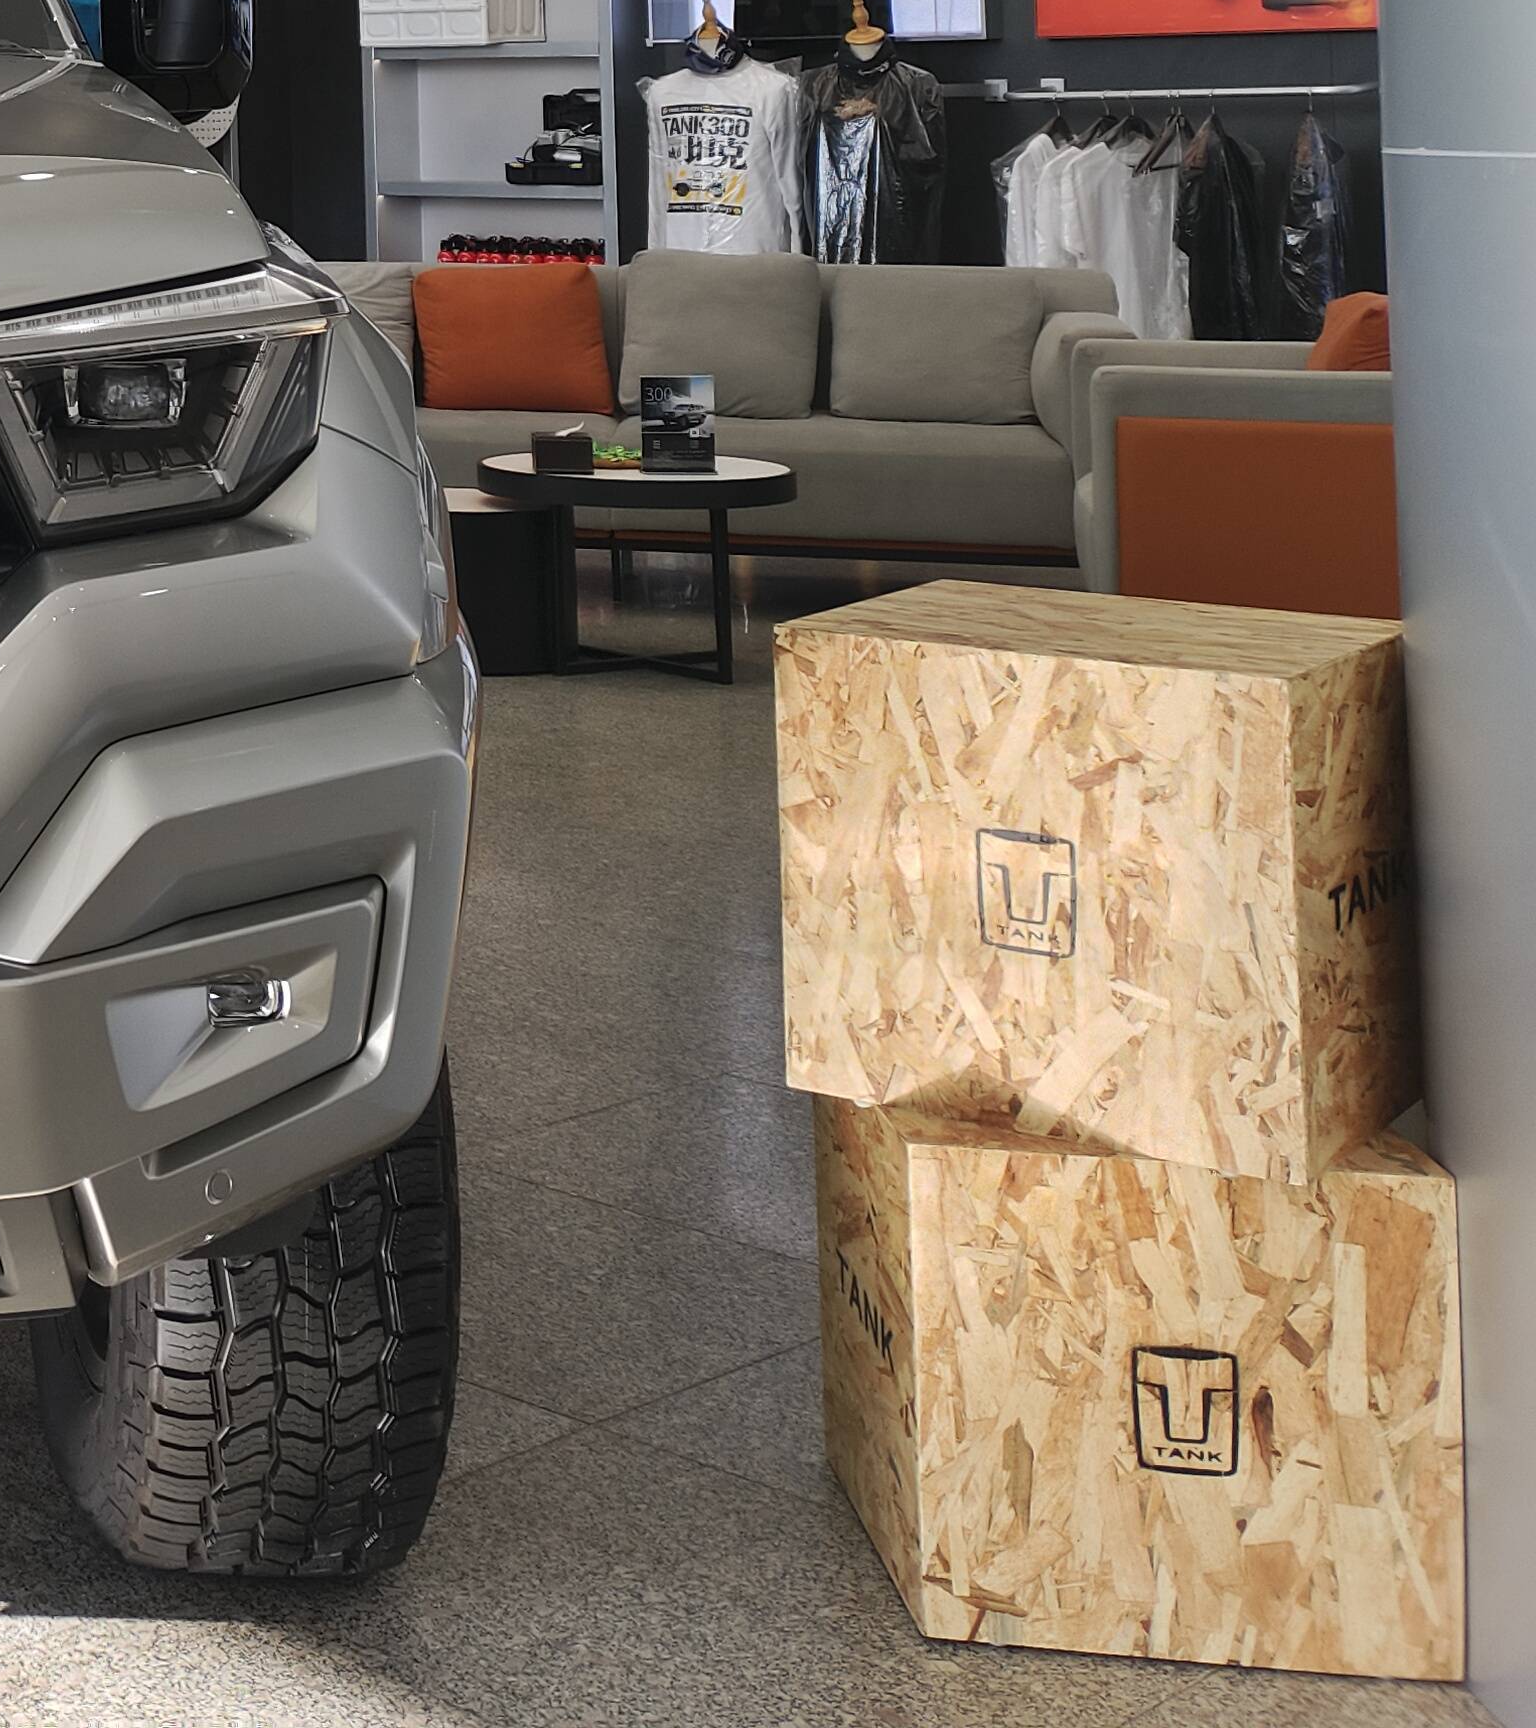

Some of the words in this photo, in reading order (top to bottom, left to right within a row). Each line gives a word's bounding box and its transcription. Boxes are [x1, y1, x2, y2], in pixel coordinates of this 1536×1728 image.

[645, 387, 673, 402] 300
[996, 924, 1061, 949] TANK
[836, 1248, 895, 1374] TANK
[1152, 1446, 1223, 1462] TANK
